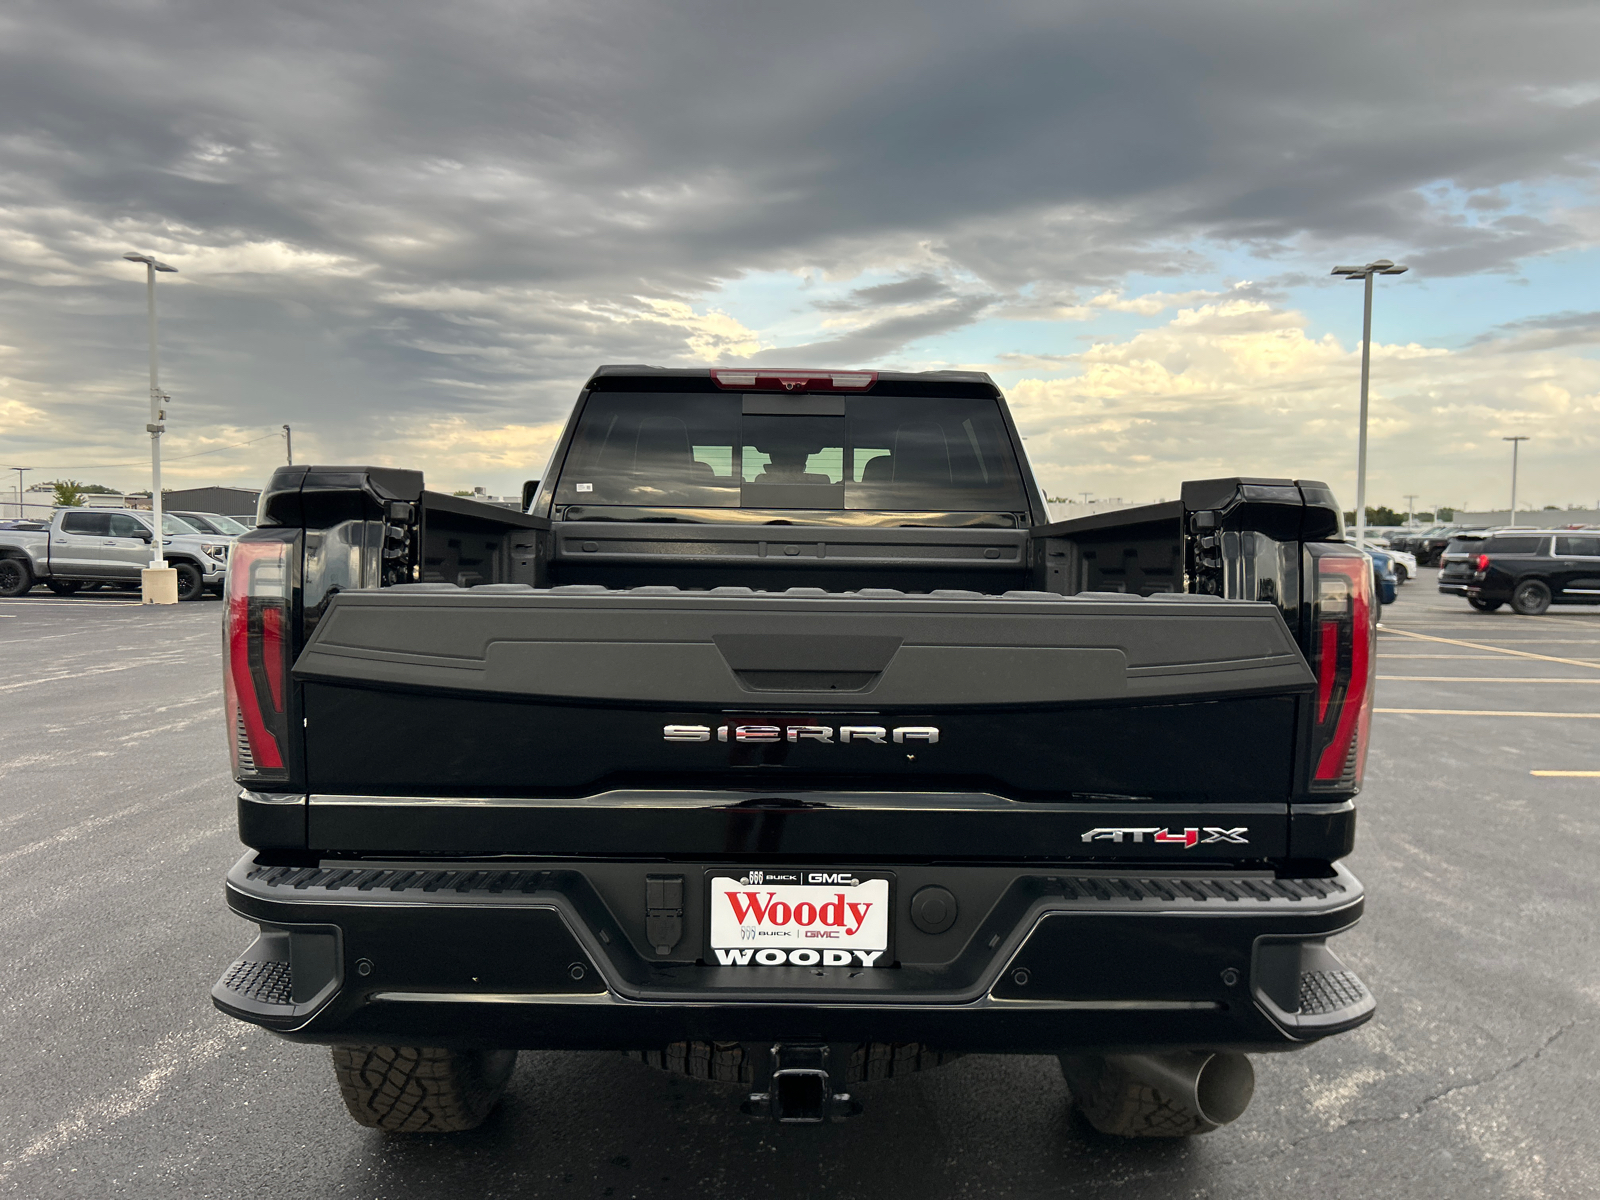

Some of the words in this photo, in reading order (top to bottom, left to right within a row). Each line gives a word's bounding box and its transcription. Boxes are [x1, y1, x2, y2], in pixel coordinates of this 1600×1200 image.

[663, 725, 939, 743] SIERRA
[1081, 827, 1249, 849] AT4X
[808, 873, 852, 884] GMC
[724, 891, 873, 936] Woody
[805, 930, 840, 939] GMC
[714, 949, 884, 967] WOODY
